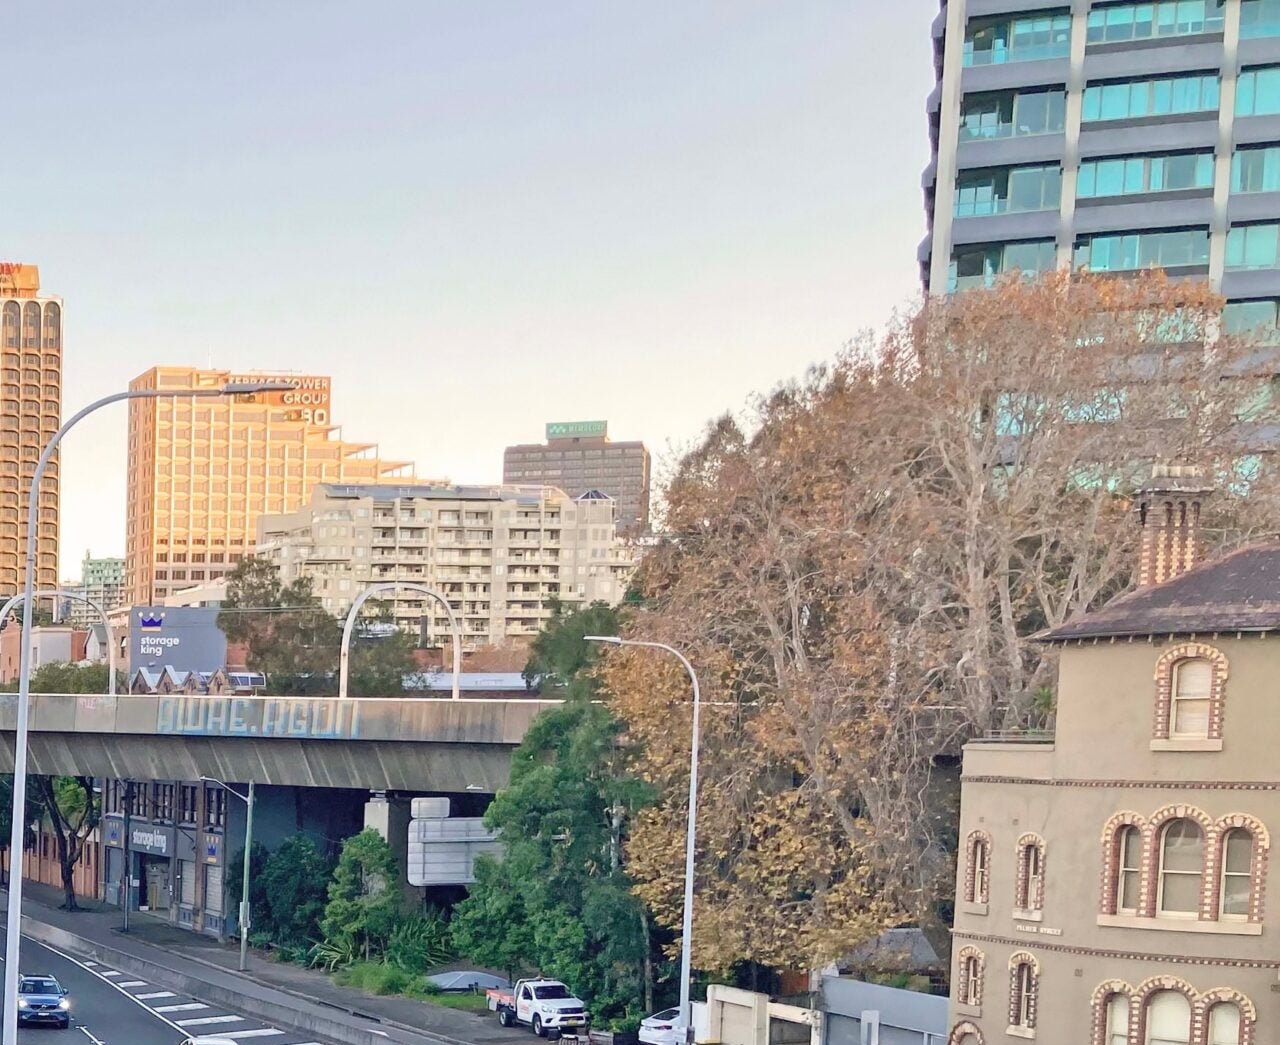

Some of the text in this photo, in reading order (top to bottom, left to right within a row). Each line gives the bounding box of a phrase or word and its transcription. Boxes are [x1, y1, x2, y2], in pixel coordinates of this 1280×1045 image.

[283, 393, 329, 405] GROUP
[140, 636, 180, 647] storage
[140, 645, 163, 657] king
[133, 828, 167, 854] storage king
